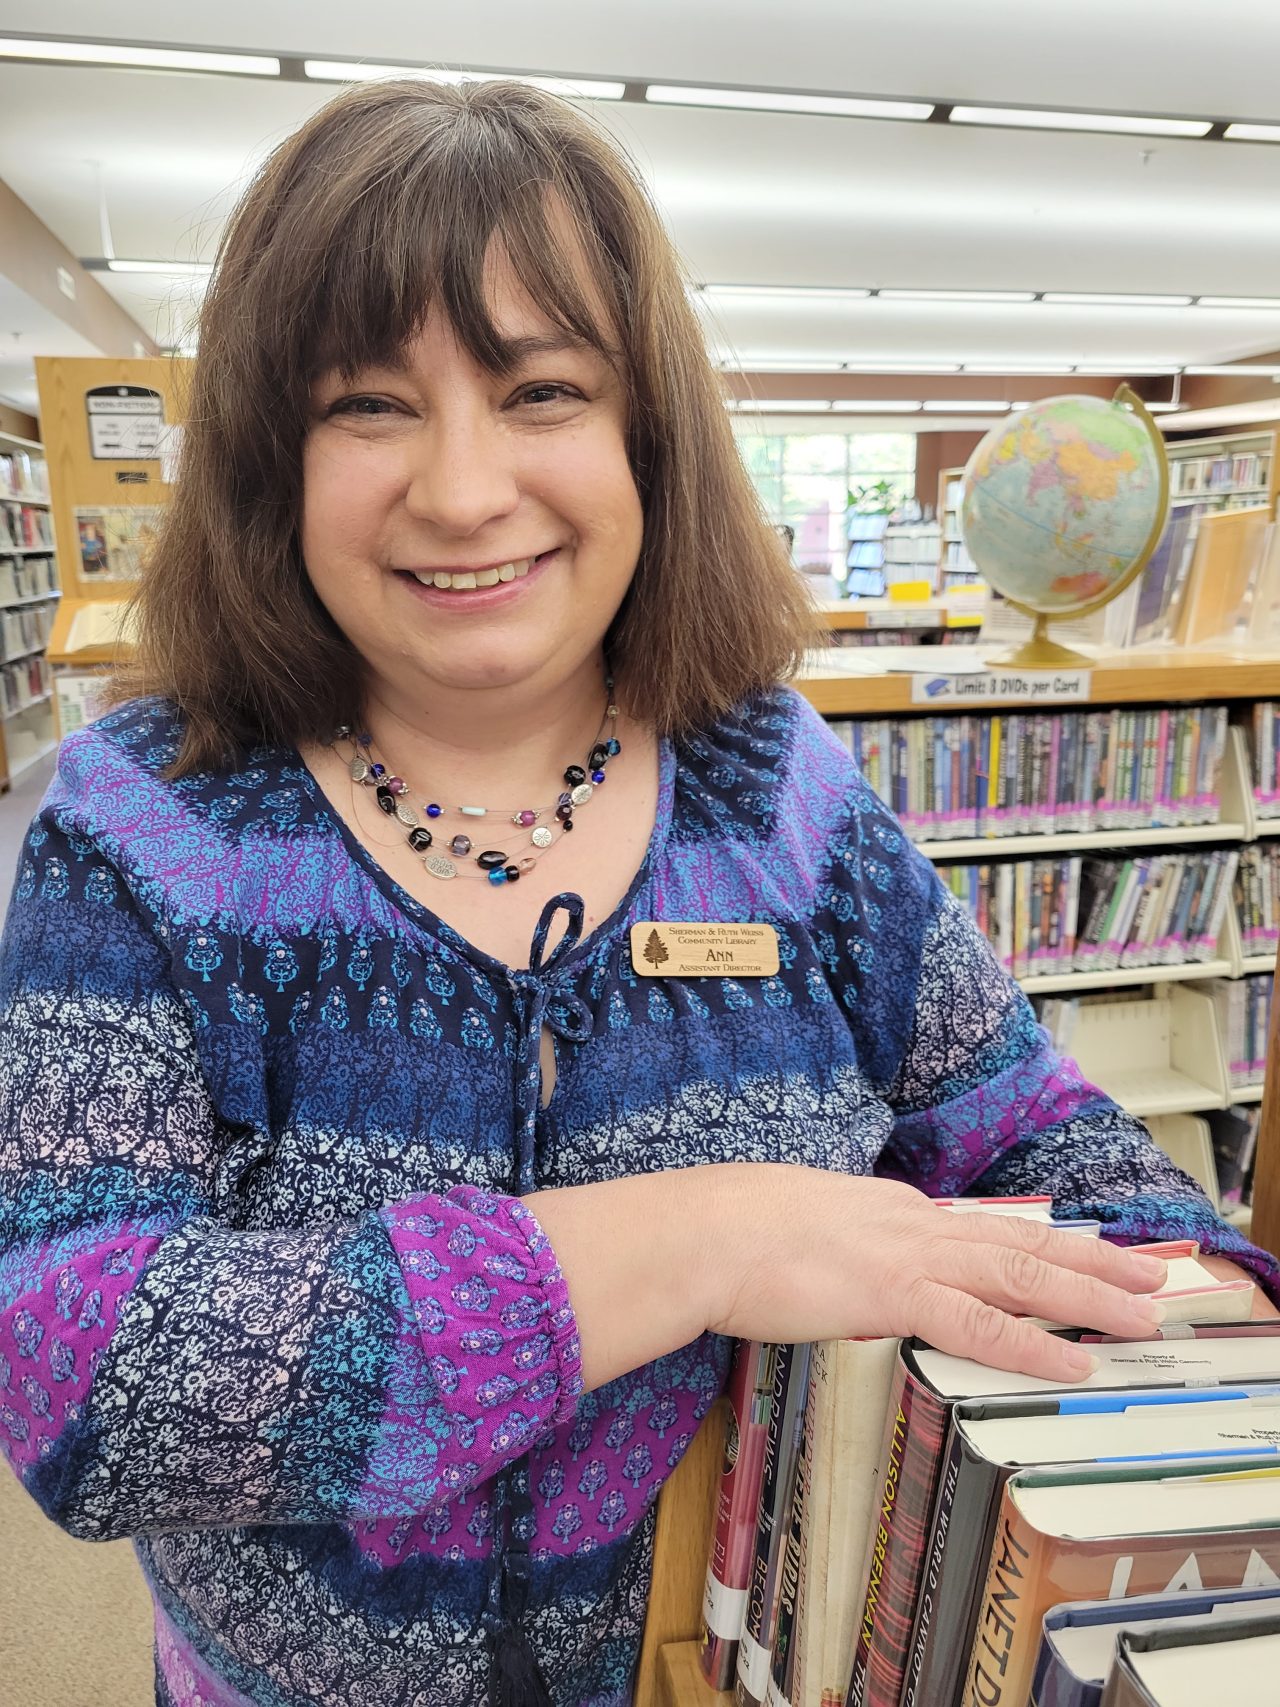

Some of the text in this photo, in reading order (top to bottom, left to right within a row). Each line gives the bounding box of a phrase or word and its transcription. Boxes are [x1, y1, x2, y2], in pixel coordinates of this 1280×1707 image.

[955, 677, 1079, 698] Limit: 8 DVDs per Card
[677, 937, 757, 945] COMMUNITY LIBRARY
[708, 928, 716, 936] &
[718, 928, 738, 936] RUTH
[740, 928, 764, 936] WEISS
[678, 964, 762, 972] ASSISTANT DIRECTOR
[705, 949, 734, 962] ANN
[943, 1459, 959, 1504] THE
[861, 1403, 907, 1650] ALLISON BRENNAN
[929, 1511, 949, 1590] WORLD
[781, 1534, 801, 1616] BIRDS
[981, 1518, 1030, 1677] JANET
[911, 1594, 933, 1682] CANNOT
[851, 1660, 867, 1707] THE
